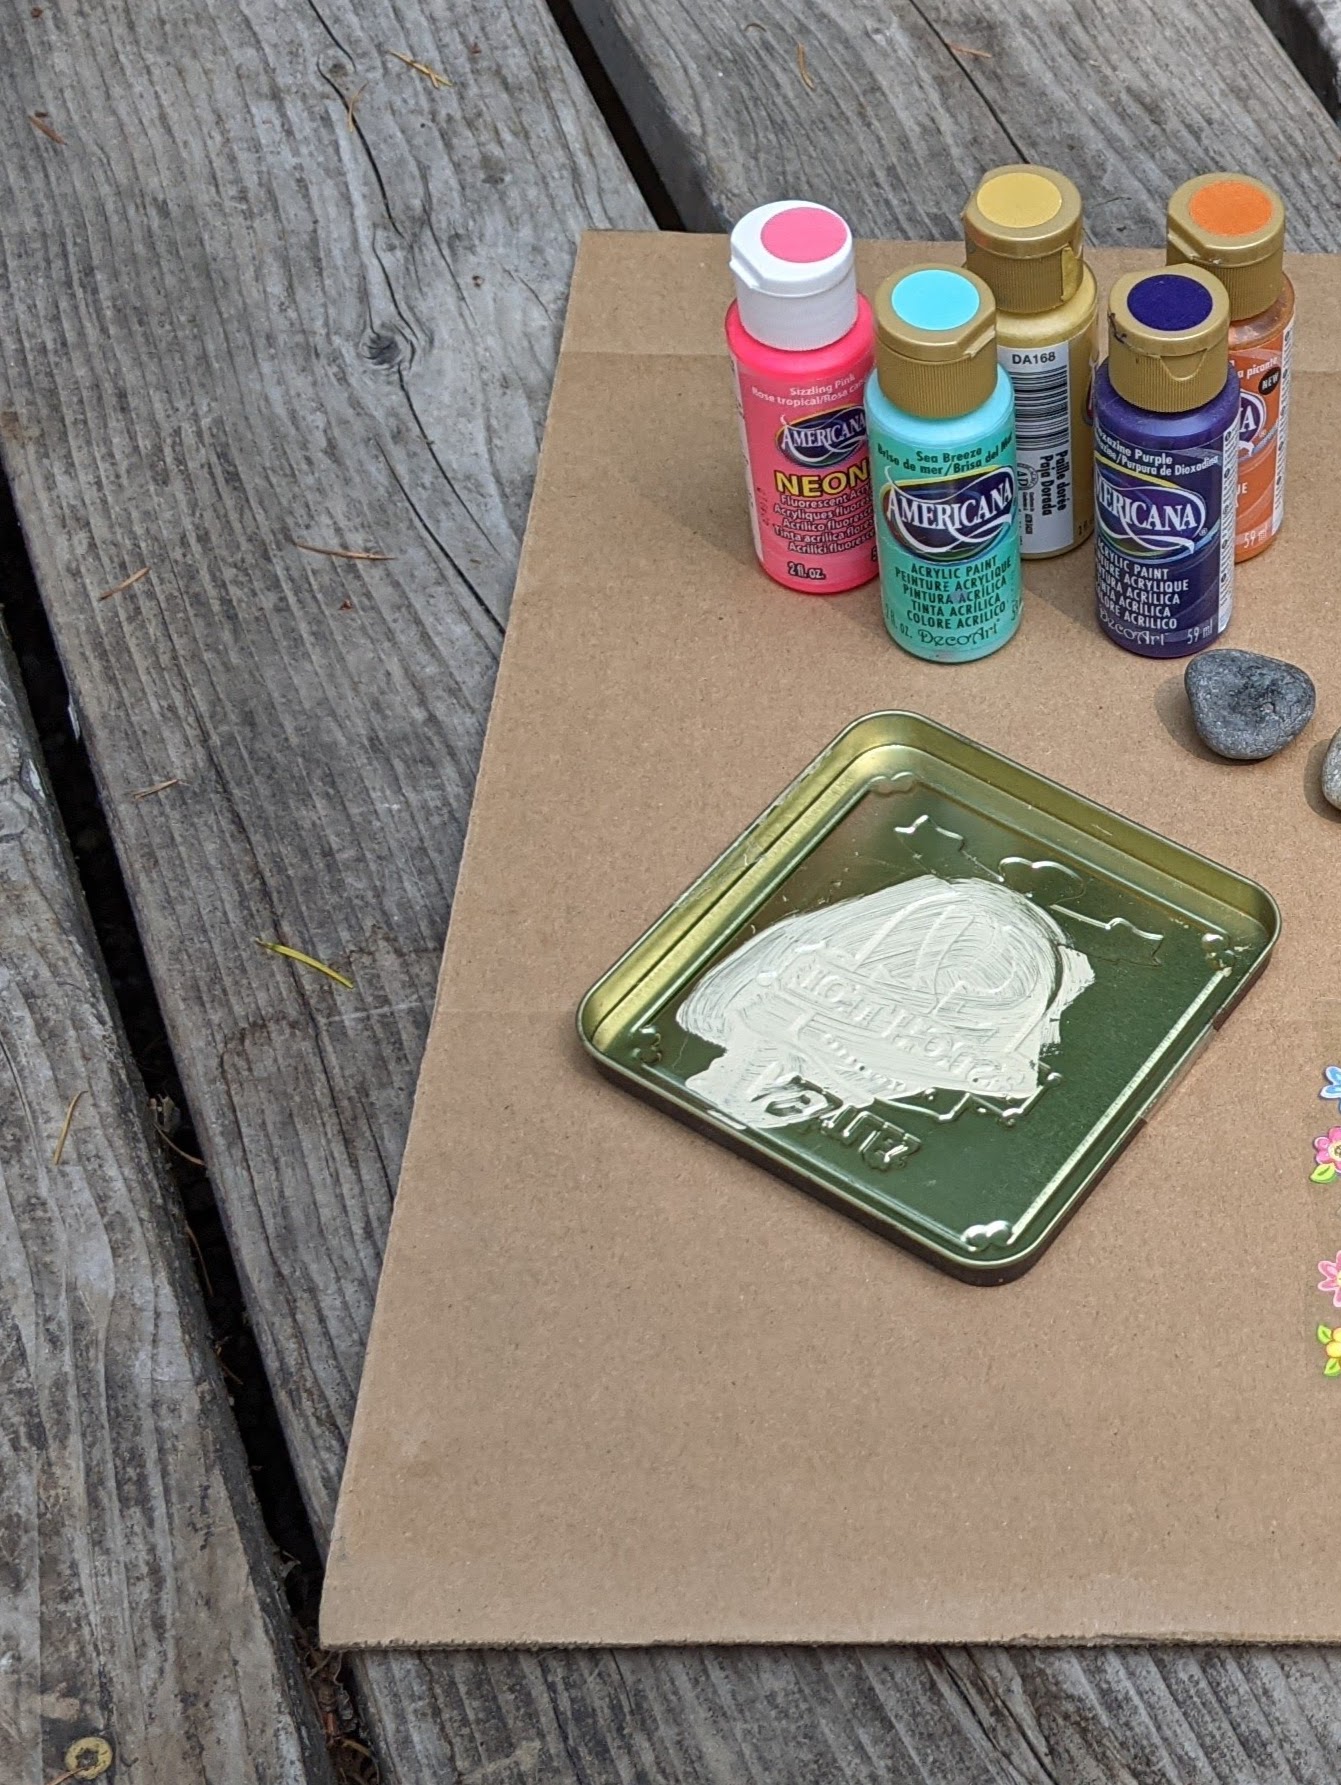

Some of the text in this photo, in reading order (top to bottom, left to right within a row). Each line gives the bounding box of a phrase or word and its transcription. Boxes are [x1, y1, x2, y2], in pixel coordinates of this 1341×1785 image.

[1011, 351, 1056, 365] DA168
[789, 373, 855, 397] Sizzling Pink
[1262, 372, 1280, 390] NEW
[903, 460, 916, 473] de
[985, 447, 1000, 464] del
[916, 447, 982, 464] Sea Breeze
[1055, 449, 1070, 480] Paille
[1134, 447, 1173, 465] Purple
[774, 462, 869, 497] NEON
[1160, 465, 1171, 476] de
[1037, 454, 1056, 516] Paja Dorada
[781, 492, 849, 507] Fluorescent
[886, 477, 1013, 530] AMERICANA
[1097, 474, 1199, 532] MERICANA
[774, 505, 833, 521] Acryliques
[774, 526, 801, 541] Tinta
[1243, 531, 1256, 548] 59
[808, 567, 824, 579] oz.
[895, 556, 1012, 592] PEINTURE ACRYLIQUE
[911, 555, 997, 580] ACRYLIC PAINT
[1134, 563, 1169, 580] PAINT
[1124, 572, 1189, 592] ACRYLIQUE
[903, 584, 953, 605] PINTURA
[907, 601, 1006, 630] COLORE ACRILICO
[912, 600, 945, 617] TINTA
[1124, 610, 1177, 630] ACRILICO
[918, 623, 997, 647] DecoArt
[1187, 627, 1199, 645] 59
[1202, 619, 1213, 639] ml
